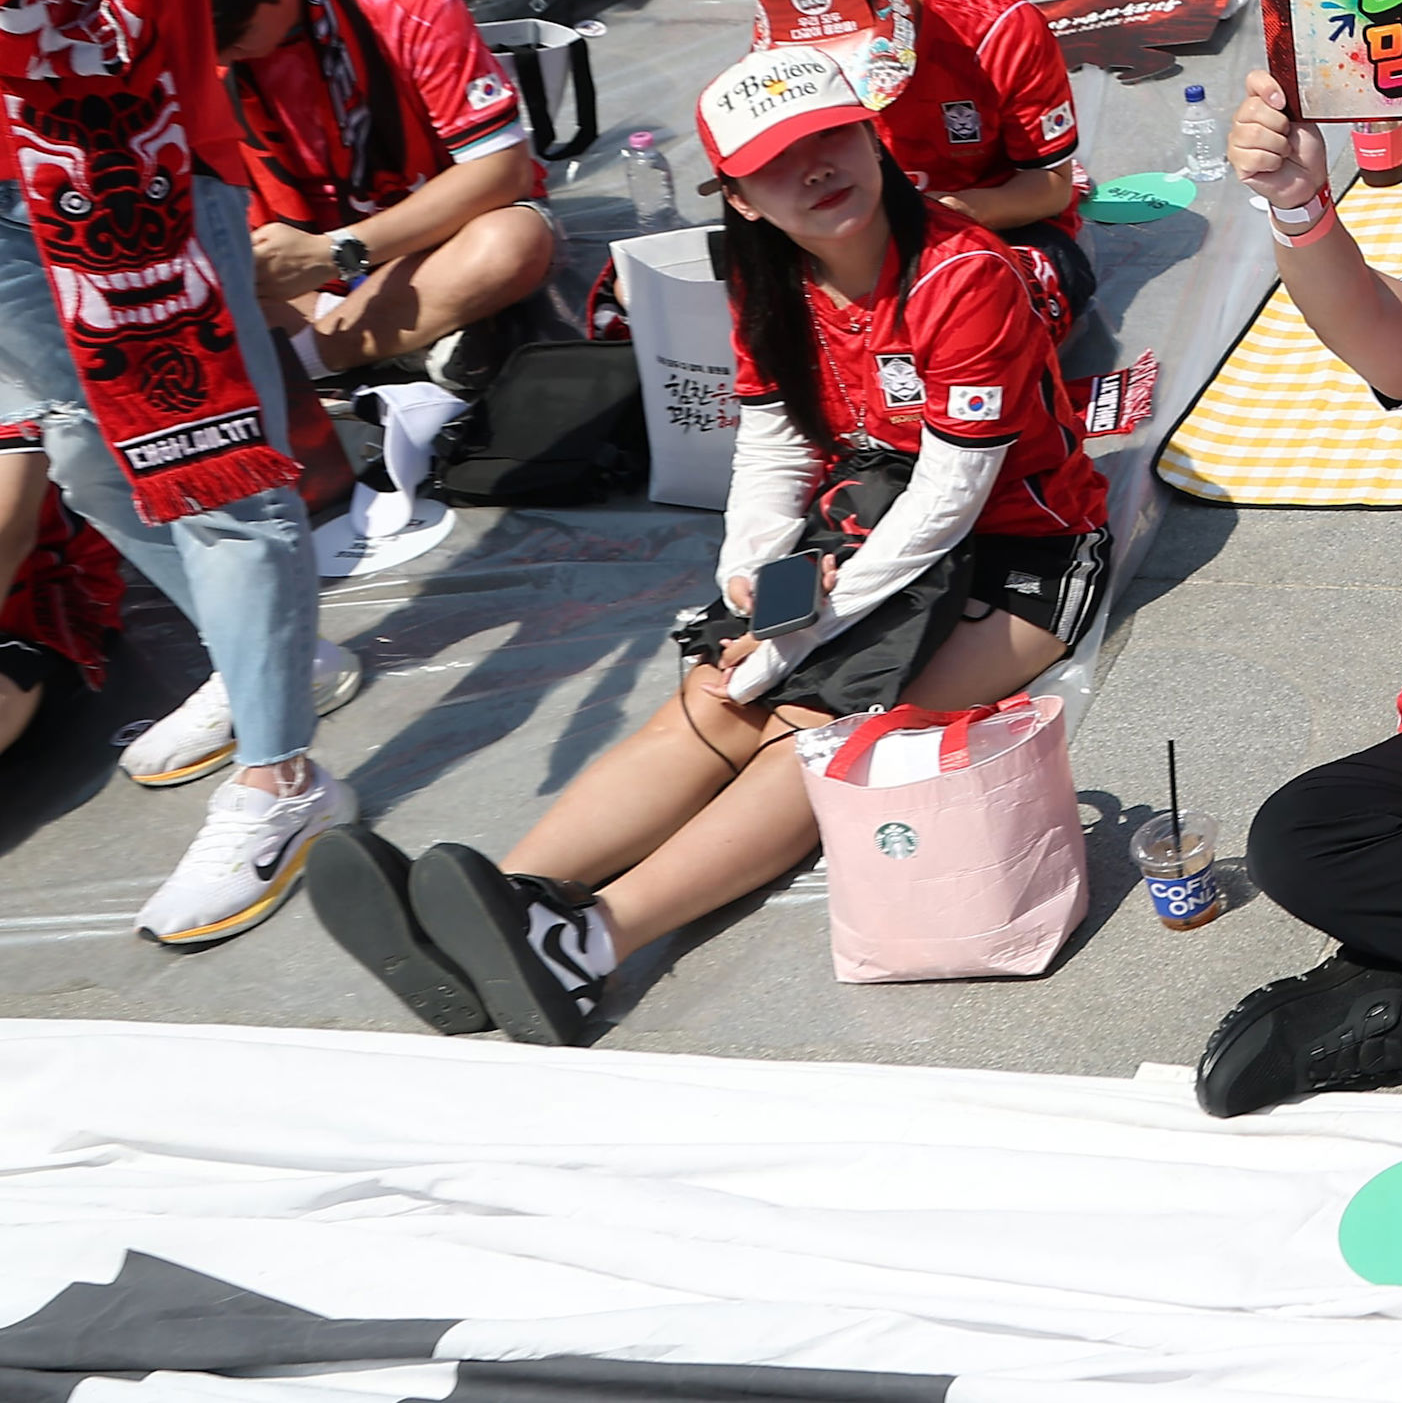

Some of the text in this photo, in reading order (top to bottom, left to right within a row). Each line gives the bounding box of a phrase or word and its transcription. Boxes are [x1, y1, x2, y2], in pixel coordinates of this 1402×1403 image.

[798, 12, 844, 28] 우리 모두
[717, 62, 827, 113] I Believe
[750, 80, 819, 119] in me
[1106, 186, 1171, 210] SkyLife
[664, 376, 712, 406] 힘찬
